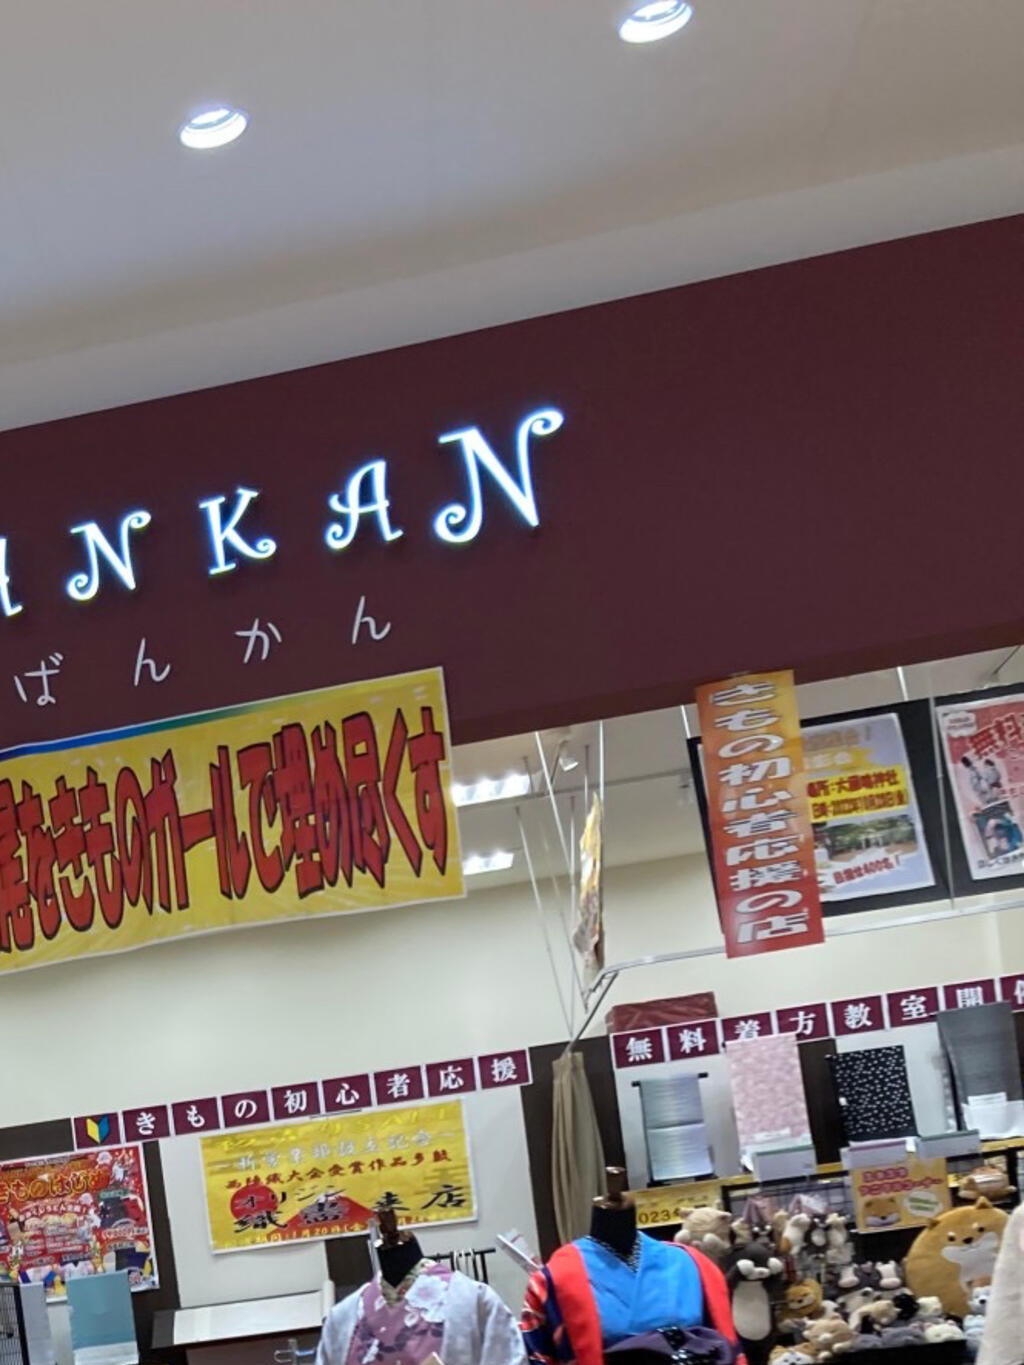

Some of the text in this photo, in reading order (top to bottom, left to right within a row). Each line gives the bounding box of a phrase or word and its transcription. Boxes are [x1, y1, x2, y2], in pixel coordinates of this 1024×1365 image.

[14, 595, 392, 706] ばんかん
[708, 679, 811, 944] きもの初心者応援の店
[136, 1055, 523, 1135] きもの初心者応援
